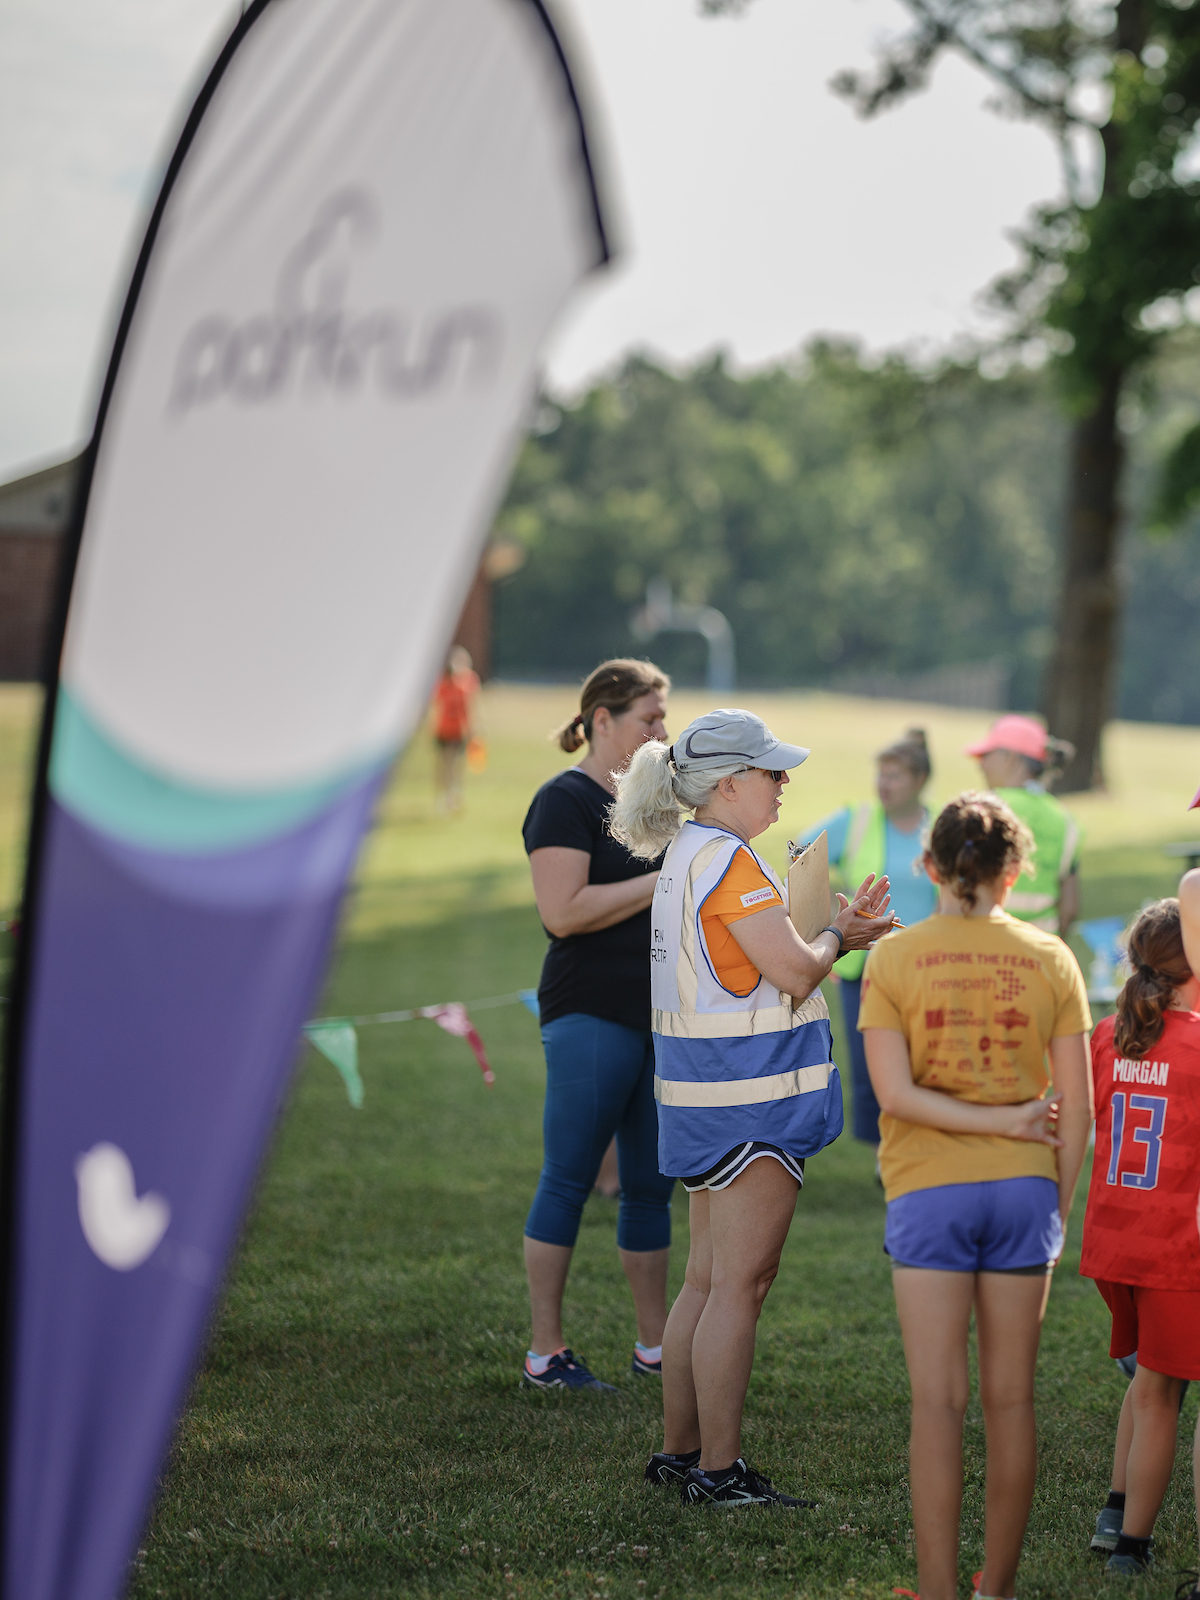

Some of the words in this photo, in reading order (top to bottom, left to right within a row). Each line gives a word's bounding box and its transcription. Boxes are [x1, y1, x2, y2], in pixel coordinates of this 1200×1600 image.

[745, 891, 772, 904] TOGETHER
[925, 951, 973, 968] BEFORE
[977, 953, 999, 966] THE
[1003, 954, 1041, 971] FEAST
[1112, 1058, 1170, 1087] MORGAN
[1106, 1091, 1169, 1191] 13
